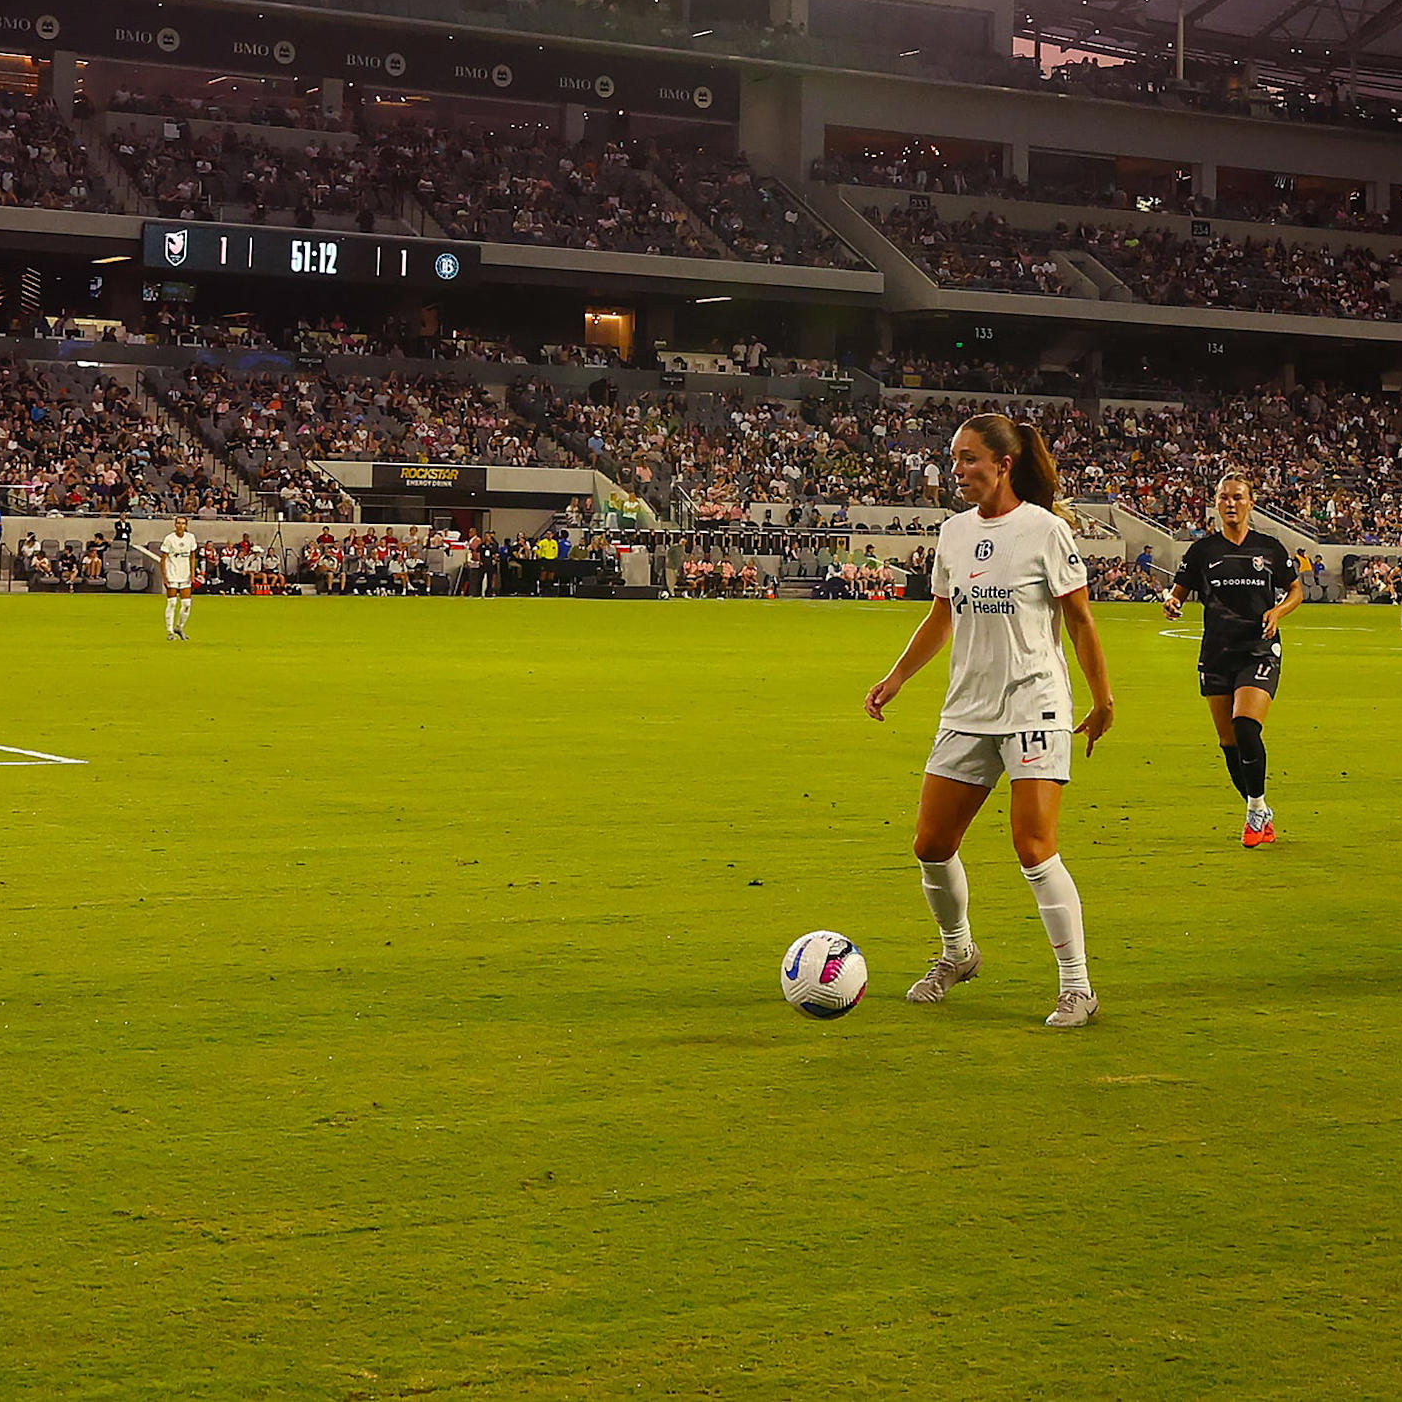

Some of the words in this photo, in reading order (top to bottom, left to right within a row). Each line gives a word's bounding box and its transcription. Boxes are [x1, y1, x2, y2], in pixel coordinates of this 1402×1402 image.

[115, 28, 153, 45] BMO
[233, 42, 269, 57] BMO
[346, 54, 381, 70] BMO
[454, 66, 488, 80] BMO
[559, 77, 592, 91] BMO
[659, 88, 690, 102] BMO
[219, 235, 229, 265] 1
[290, 239, 339, 275] 51:12
[400, 249, 408, 277] 1
[974, 327, 994, 340] 133
[1206, 342, 1225, 355] 134
[400, 468, 459, 479] ROCKSTAR
[1222, 578, 1266, 587] DOORDASH
[971, 585, 1014, 599] Sutter
[972, 601, 1015, 615] Health
[1020, 731, 1047, 753] 14
